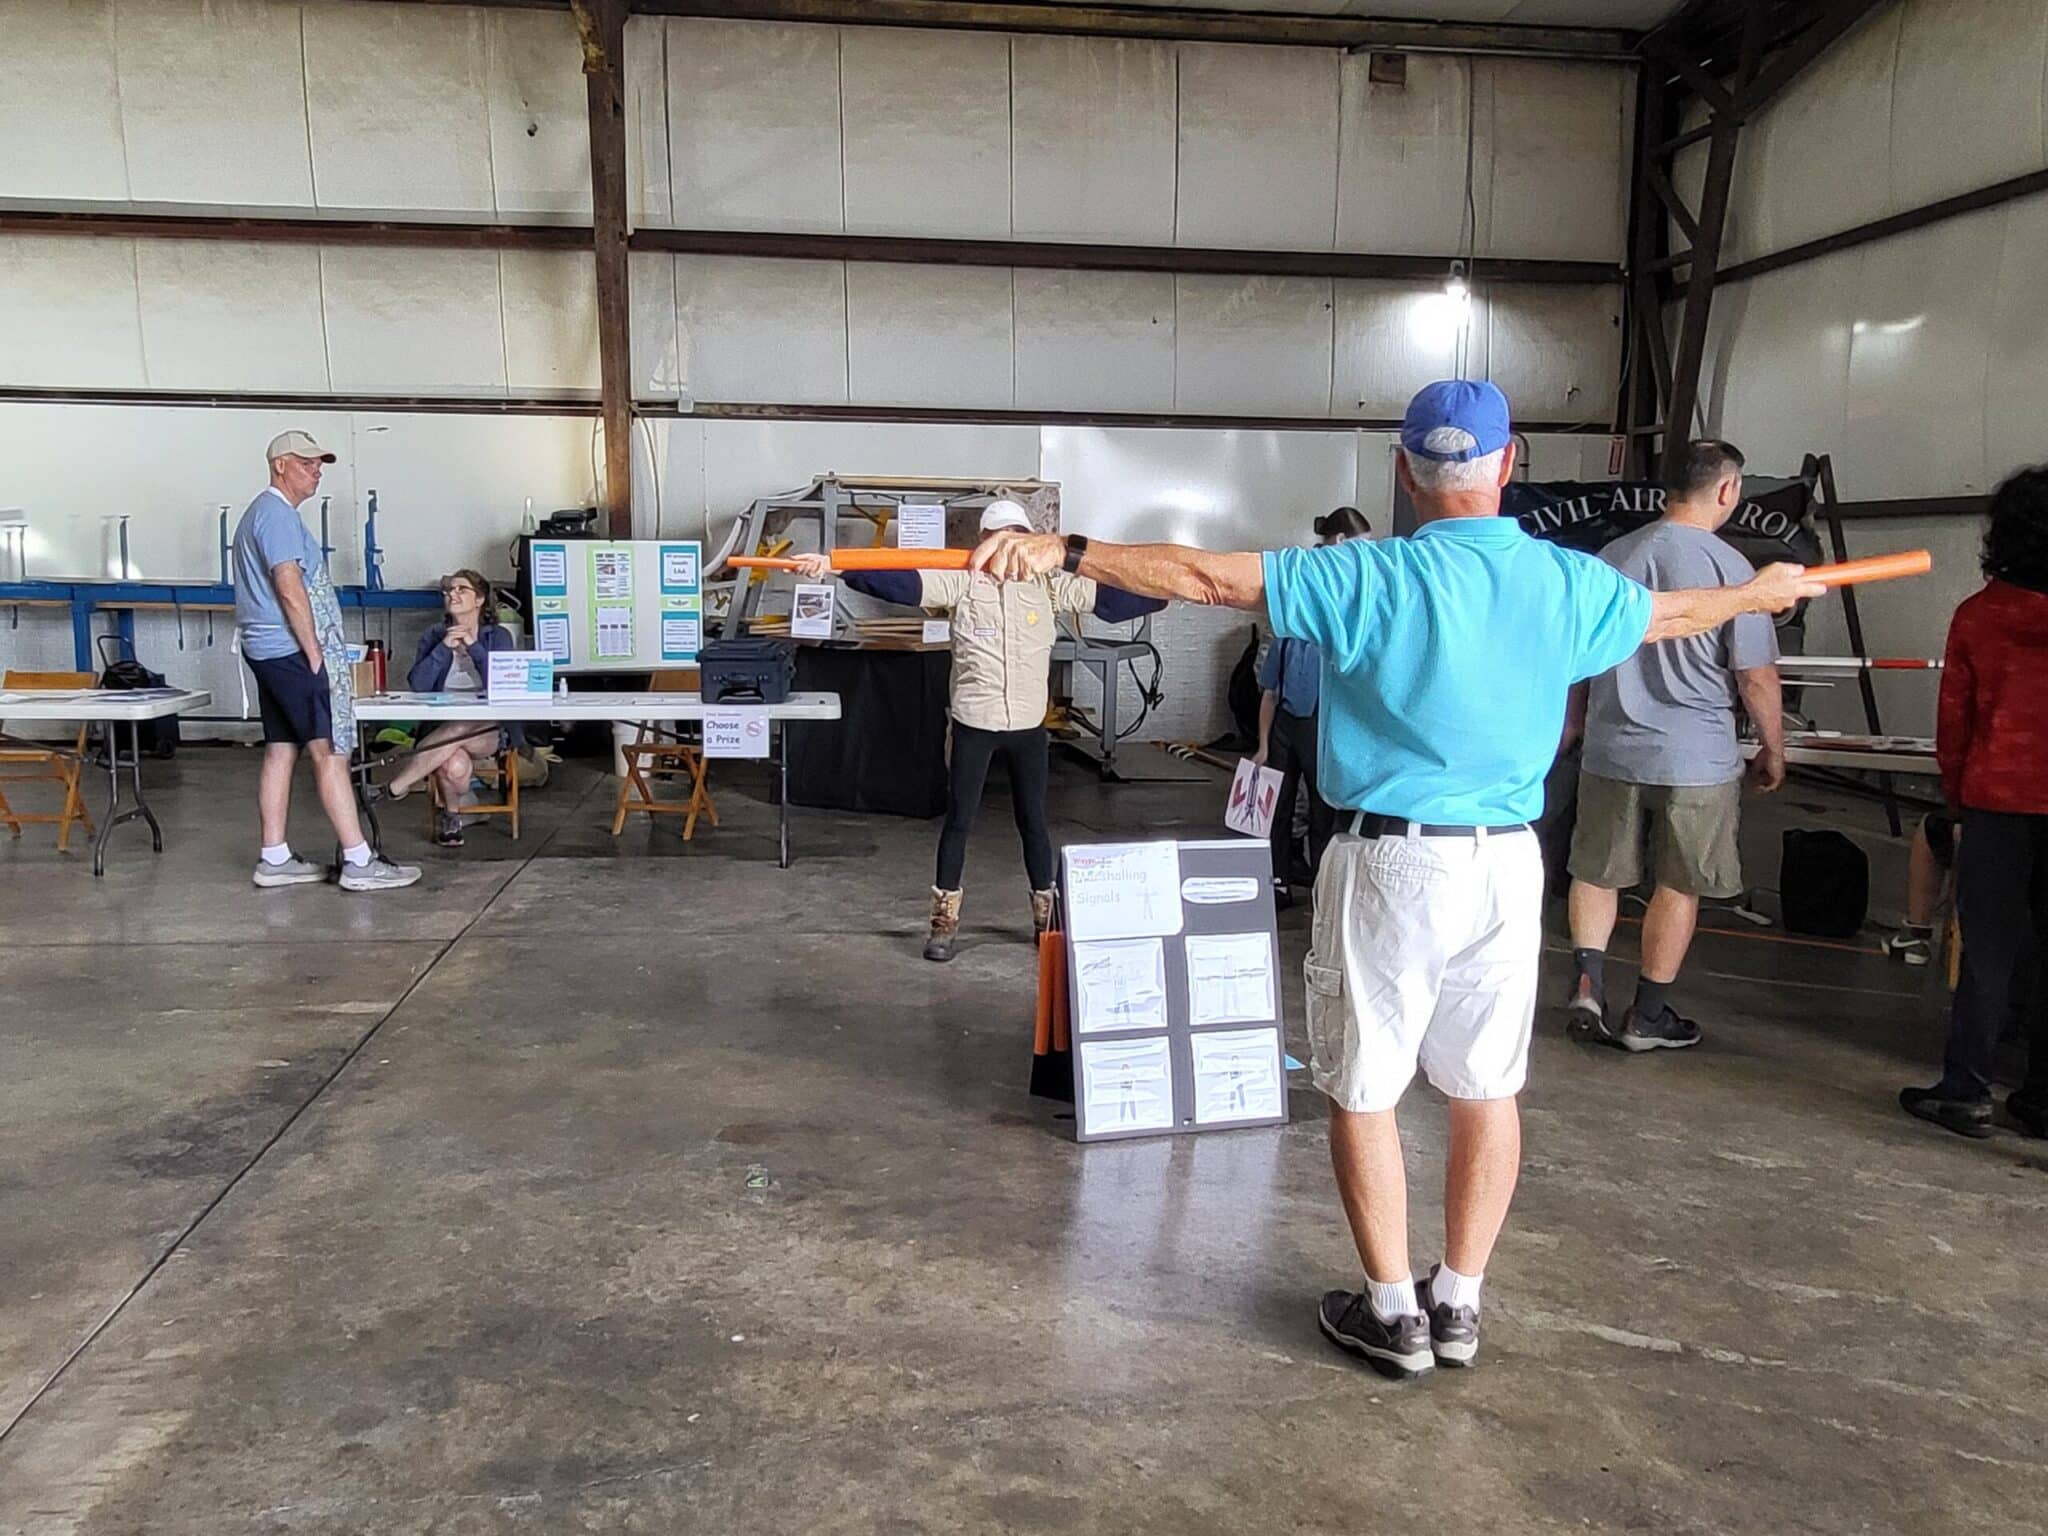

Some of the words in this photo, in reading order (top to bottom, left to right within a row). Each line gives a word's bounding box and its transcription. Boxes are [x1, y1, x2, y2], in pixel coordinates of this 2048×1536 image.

[1608, 487, 1668, 512] AIR
[706, 720, 739, 729] Choose
[706, 736, 713, 744] a
[716, 734, 741, 744] Prize
[1072, 867, 1147, 884] shalling
[1076, 889, 1121, 905] Signals
